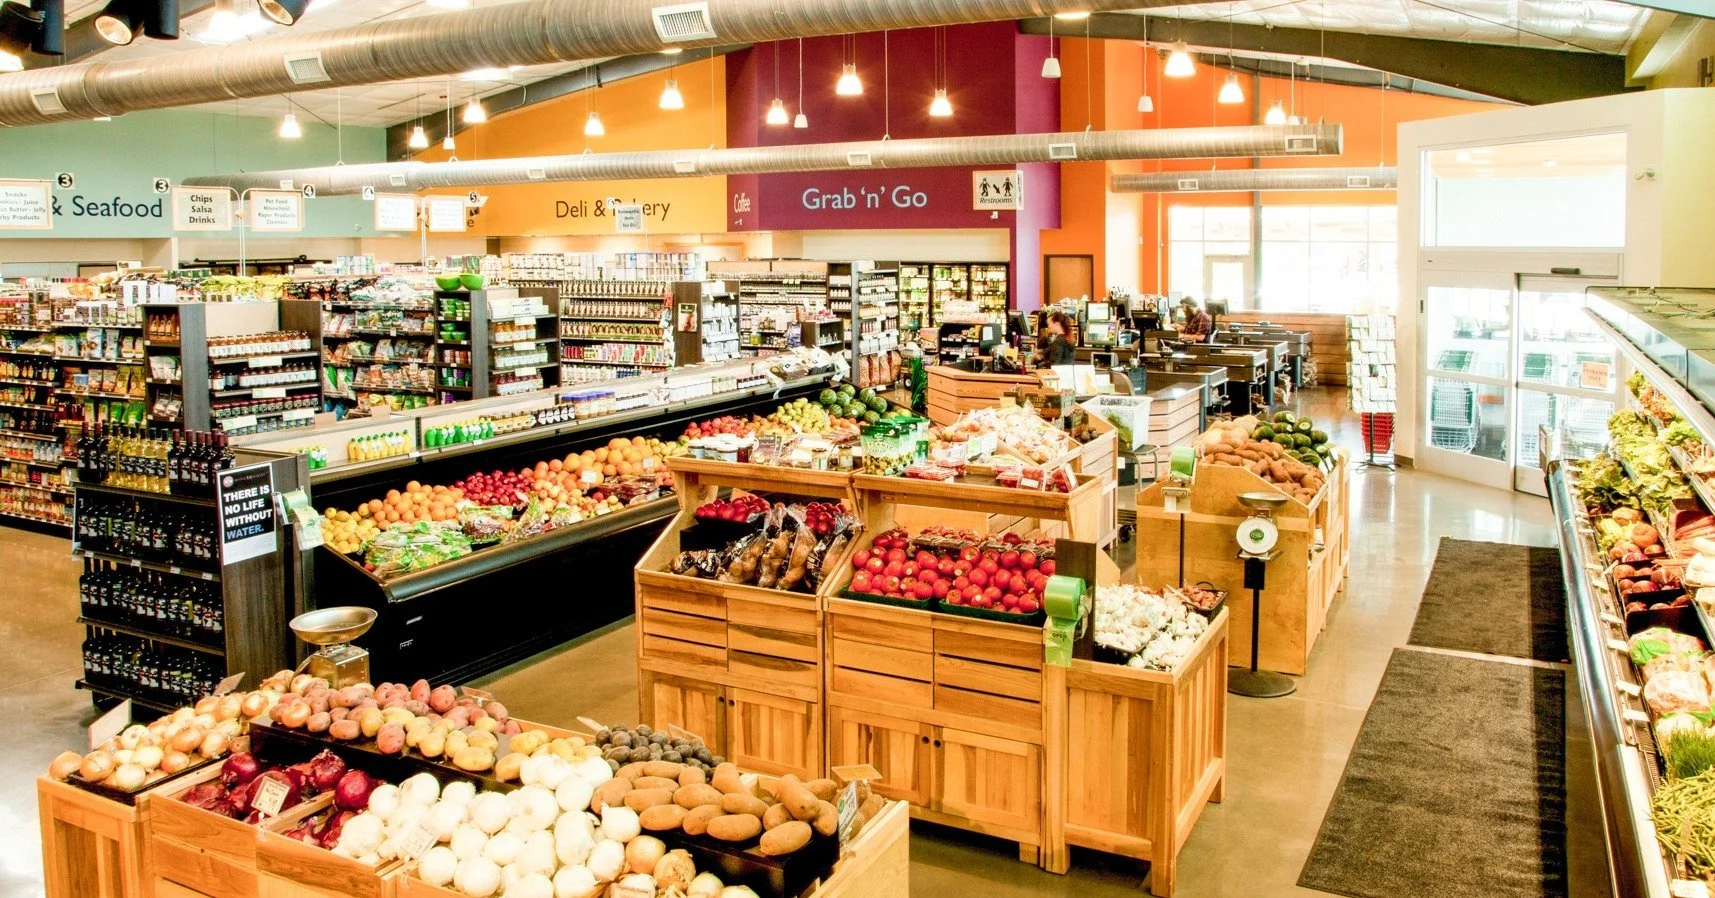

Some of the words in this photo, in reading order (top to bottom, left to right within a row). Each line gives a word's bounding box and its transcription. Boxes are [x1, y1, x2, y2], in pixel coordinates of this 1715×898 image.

[59, 174, 72, 188] 3
[156, 180, 168, 192] 3
[304, 185, 314, 197] 4
[802, 187, 856, 209] Grab
[891, 185, 927, 208] Go
[72, 195, 162, 217] Seafood
[190, 194, 213, 205] Chips
[734, 192, 750, 213] Coffee
[191, 205, 213, 213] Salsa
[556, 199, 587, 218] Deli
[594, 199, 606, 217] &
[613, 198, 670, 221] ery
[189, 216, 216, 224] Drinks
[223, 487, 258, 503] THERE
[259, 484, 270, 495] IS
[224, 503, 241, 515] NO
[242, 498, 265, 511] LIFE
[225, 508, 273, 528] WITHOUT
[226, 524, 264, 540] WATER.
